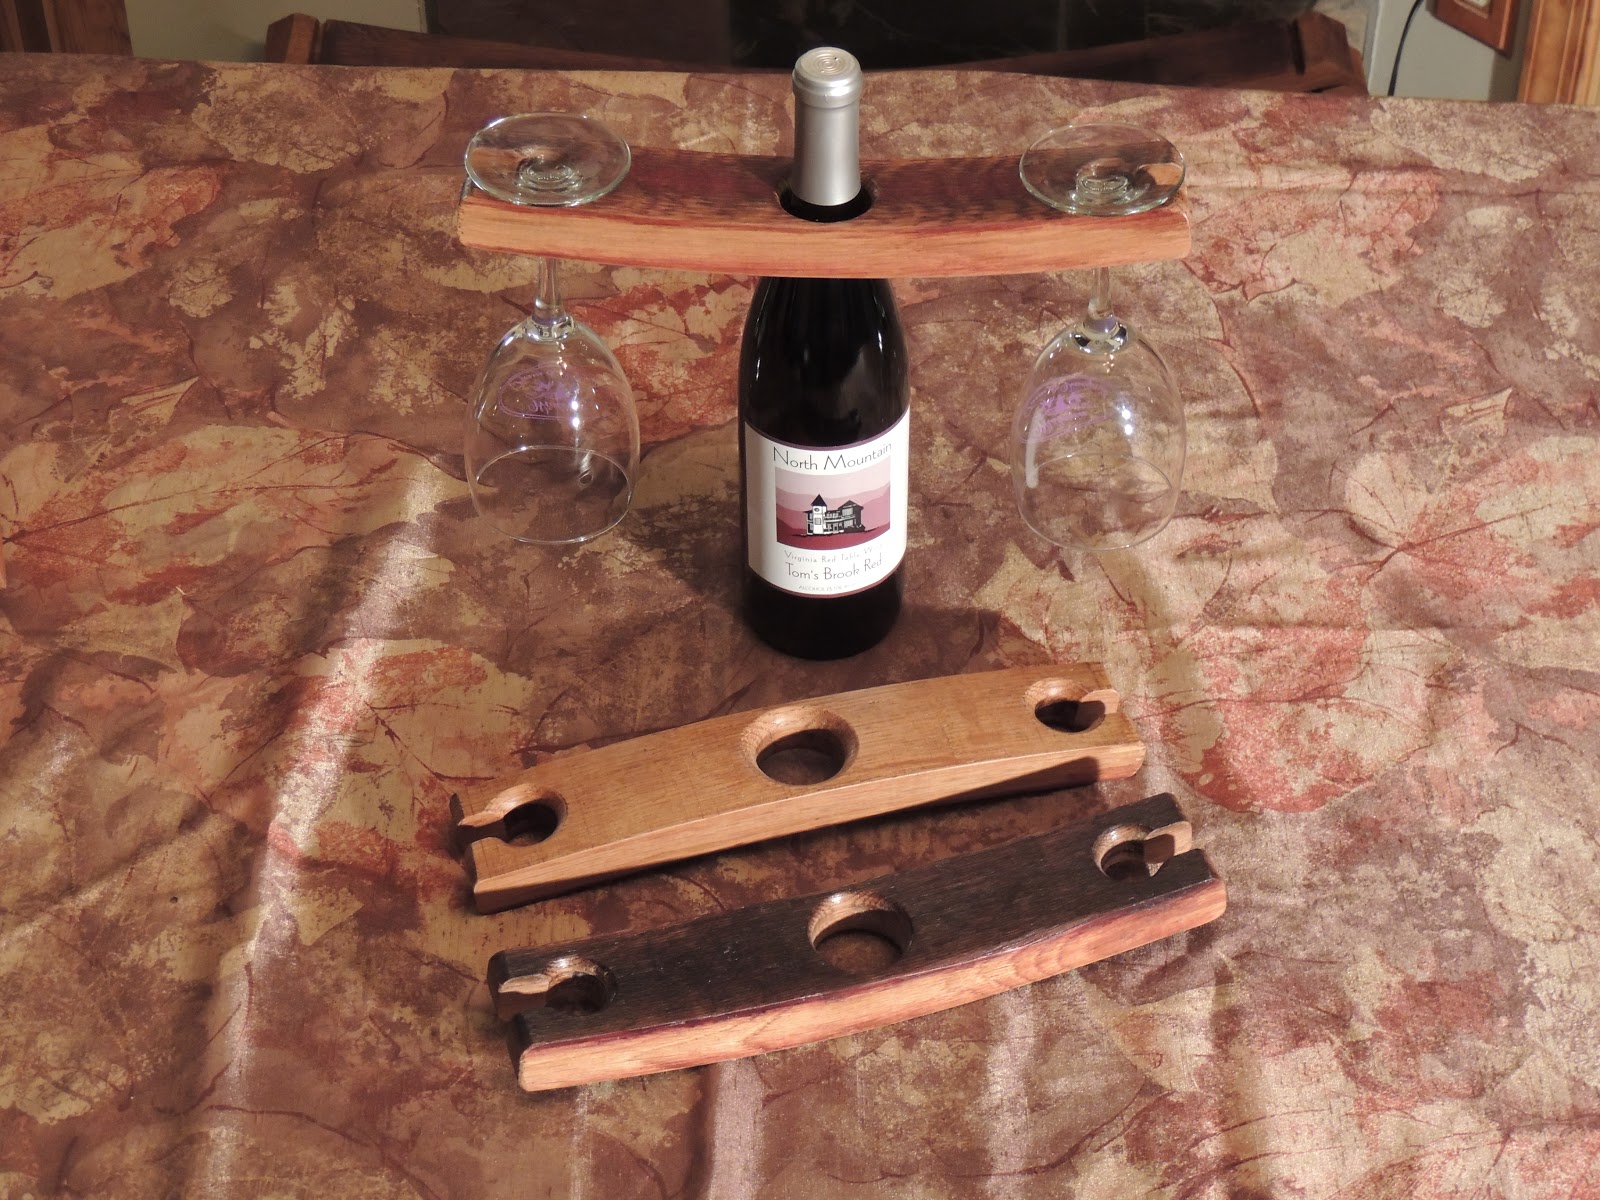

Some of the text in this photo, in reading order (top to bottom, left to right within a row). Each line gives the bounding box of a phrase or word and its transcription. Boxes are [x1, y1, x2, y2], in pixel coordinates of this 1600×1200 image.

[773, 443, 893, 471] North Mountain
[784, 550, 861, 563] Virginia Red Table
[785, 552, 883, 580] Tom's Brook Red
